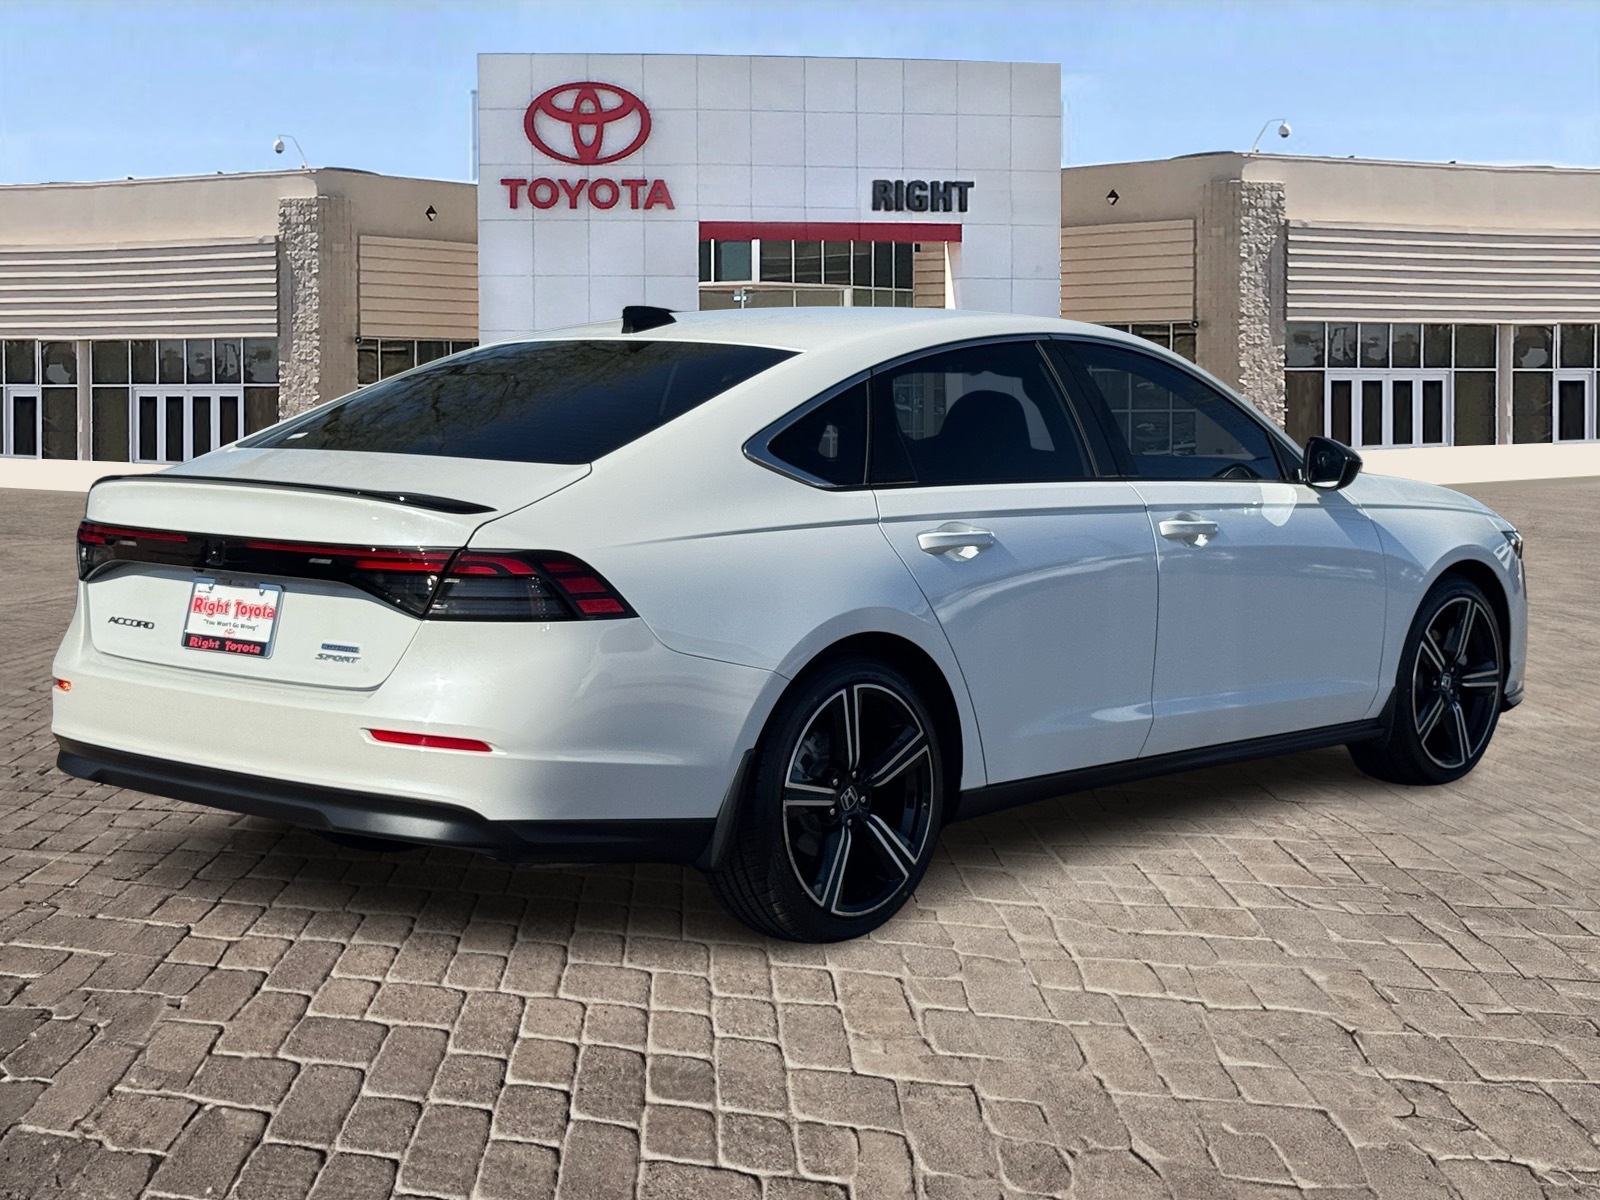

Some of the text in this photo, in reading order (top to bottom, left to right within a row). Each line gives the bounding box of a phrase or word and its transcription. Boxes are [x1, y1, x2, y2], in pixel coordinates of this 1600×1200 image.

[500, 177, 675, 210] TOYOTA
[871, 179, 975, 212] RIGHT
[192, 596, 275, 620] Right Toyota
[107, 616, 155, 629] ACCORD
[189, 636, 261, 653] Right Toyota
[315, 653, 361, 663] SPORT
